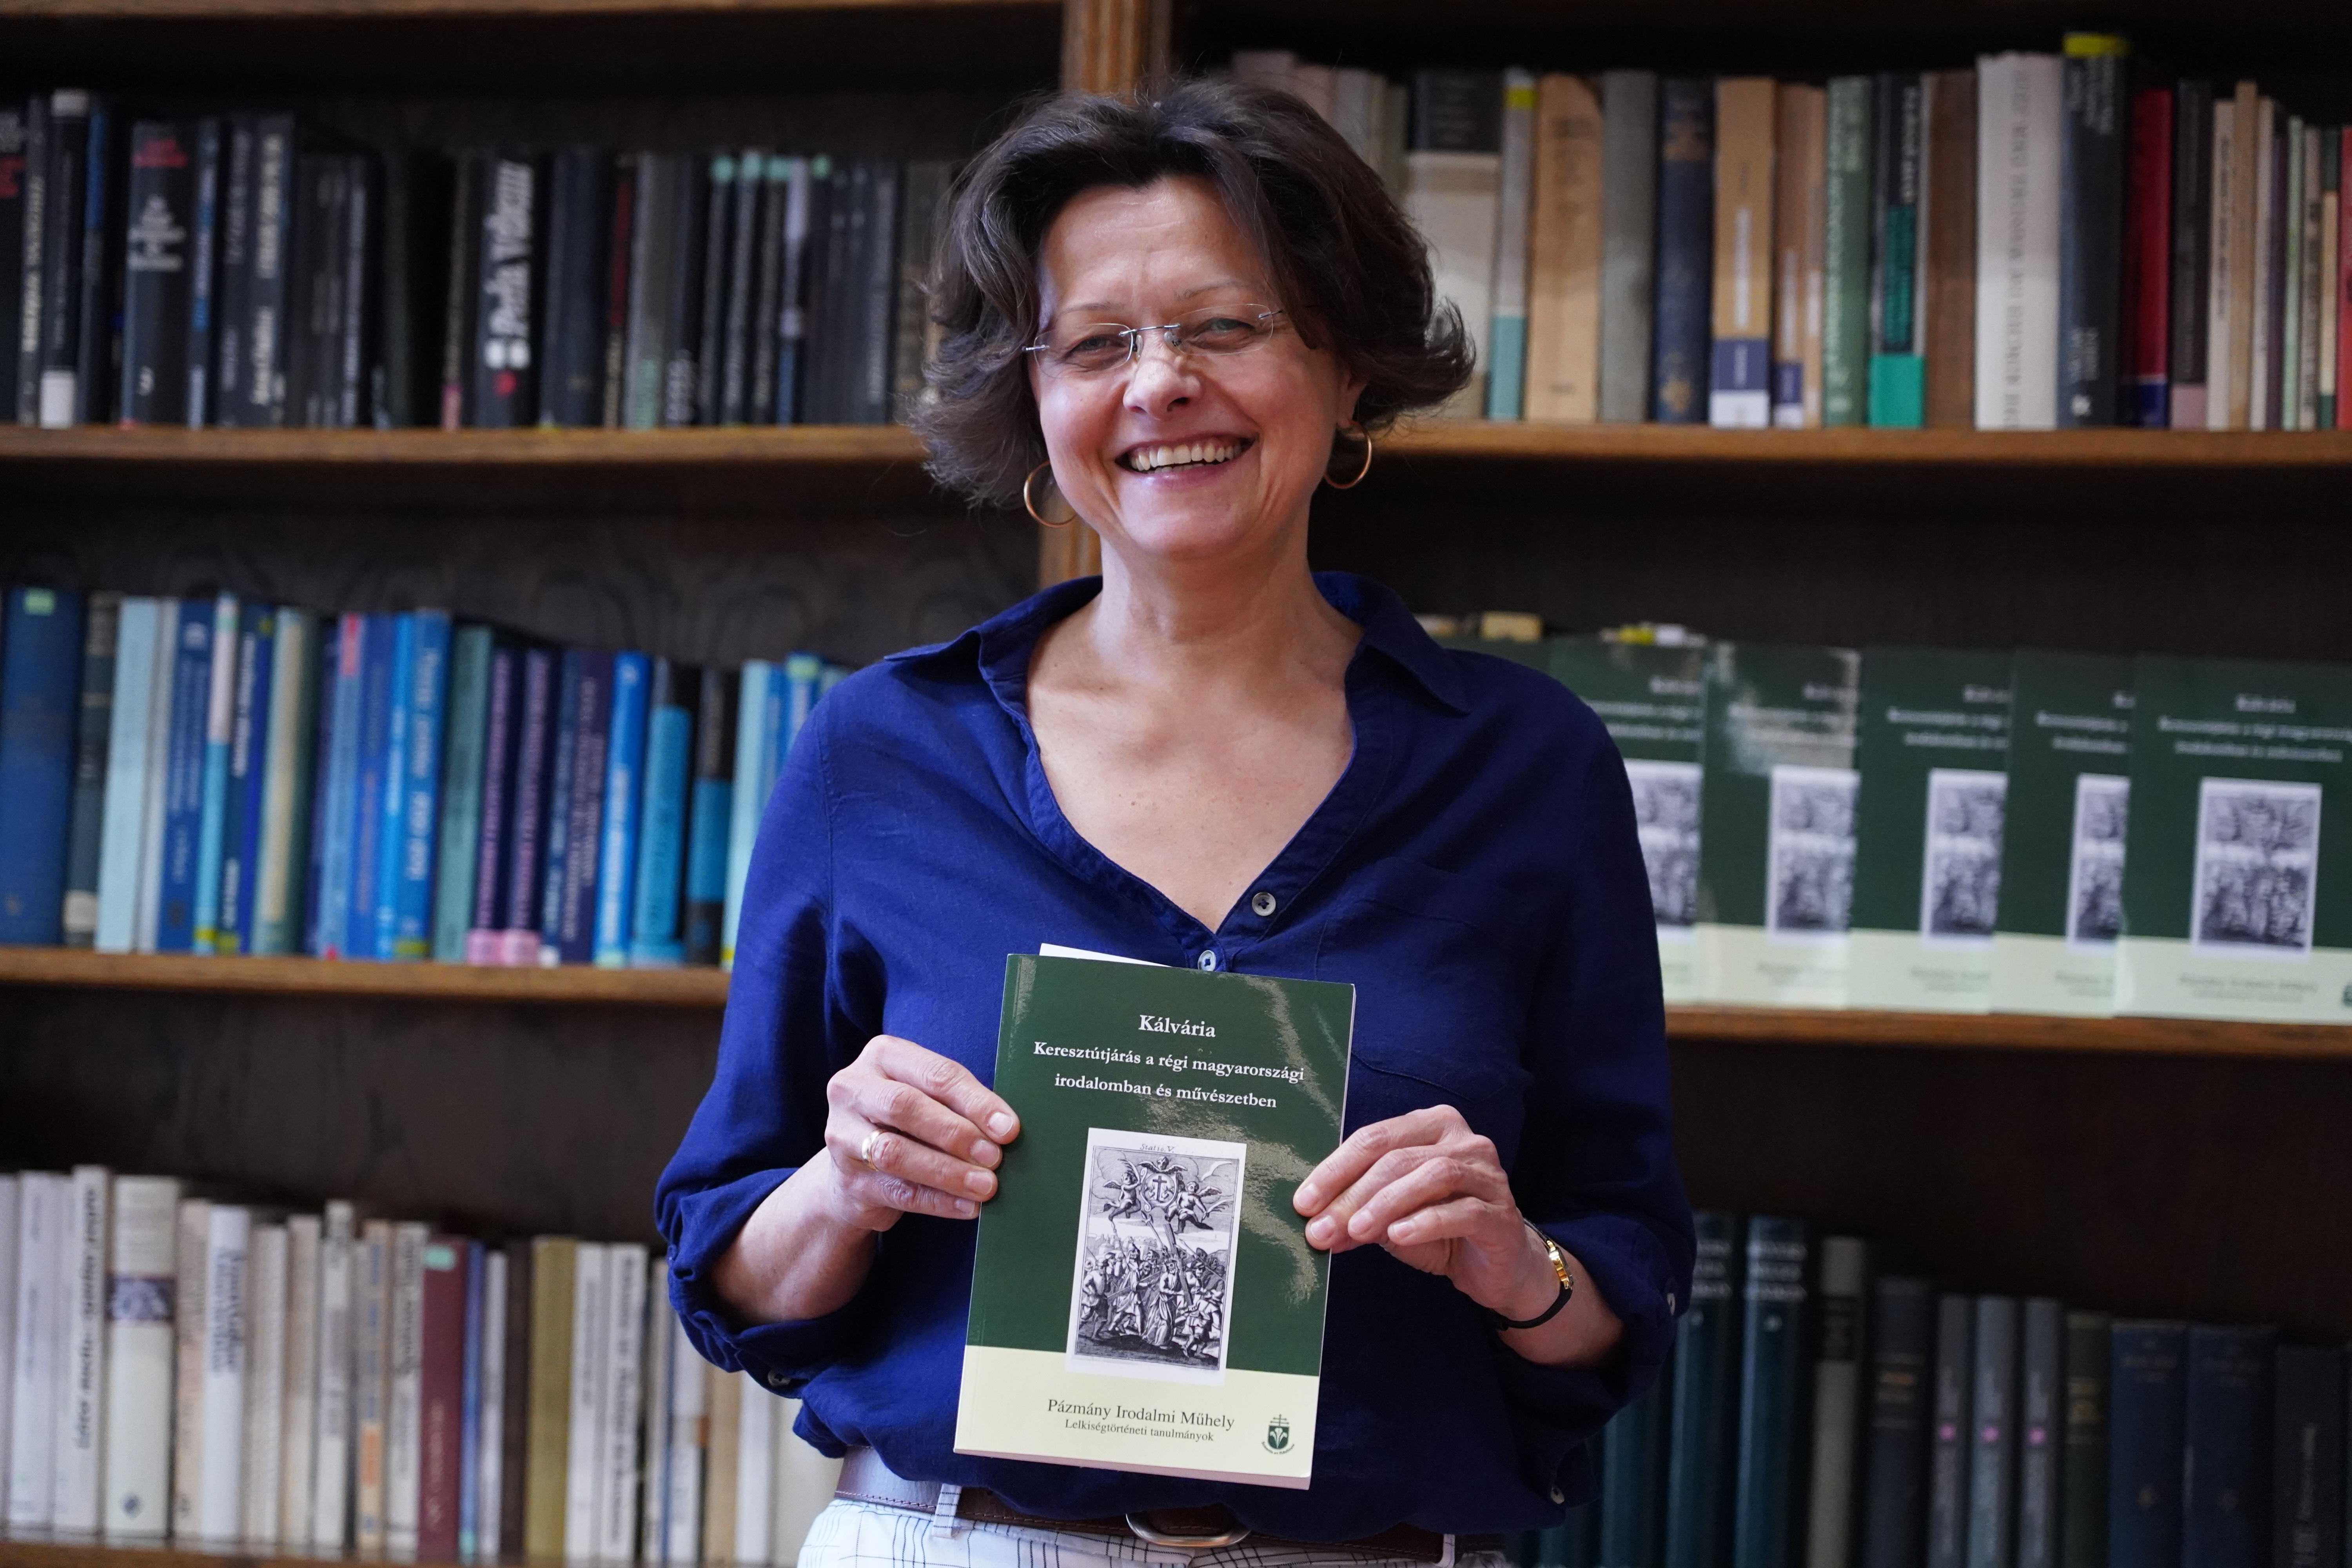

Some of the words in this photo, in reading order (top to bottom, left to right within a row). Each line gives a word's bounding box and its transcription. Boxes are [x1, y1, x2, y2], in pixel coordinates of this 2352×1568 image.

[1138, 1014, 1216, 1037] Kálvária
[1033, 1042, 1141, 1064] Keresztútjárás
[1146, 1056, 1154, 1065] a
[1158, 1054, 1188, 1072] régi
[1192, 1060, 1304, 1084] magyarországi
[1054, 1073, 1152, 1095] irodalomban
[1156, 1084, 1172, 1097] és
[1176, 1087, 1277, 1108] művészetben
[1048, 1399, 1112, 1419] Pázmány
[1116, 1405, 1175, 1423] Irodalmi
[1180, 1411, 1235, 1431] Műhely
[1065, 1419, 1147, 1435] Lelkiségtörténeti
[1151, 1428, 1214, 1442] tanulmányok
